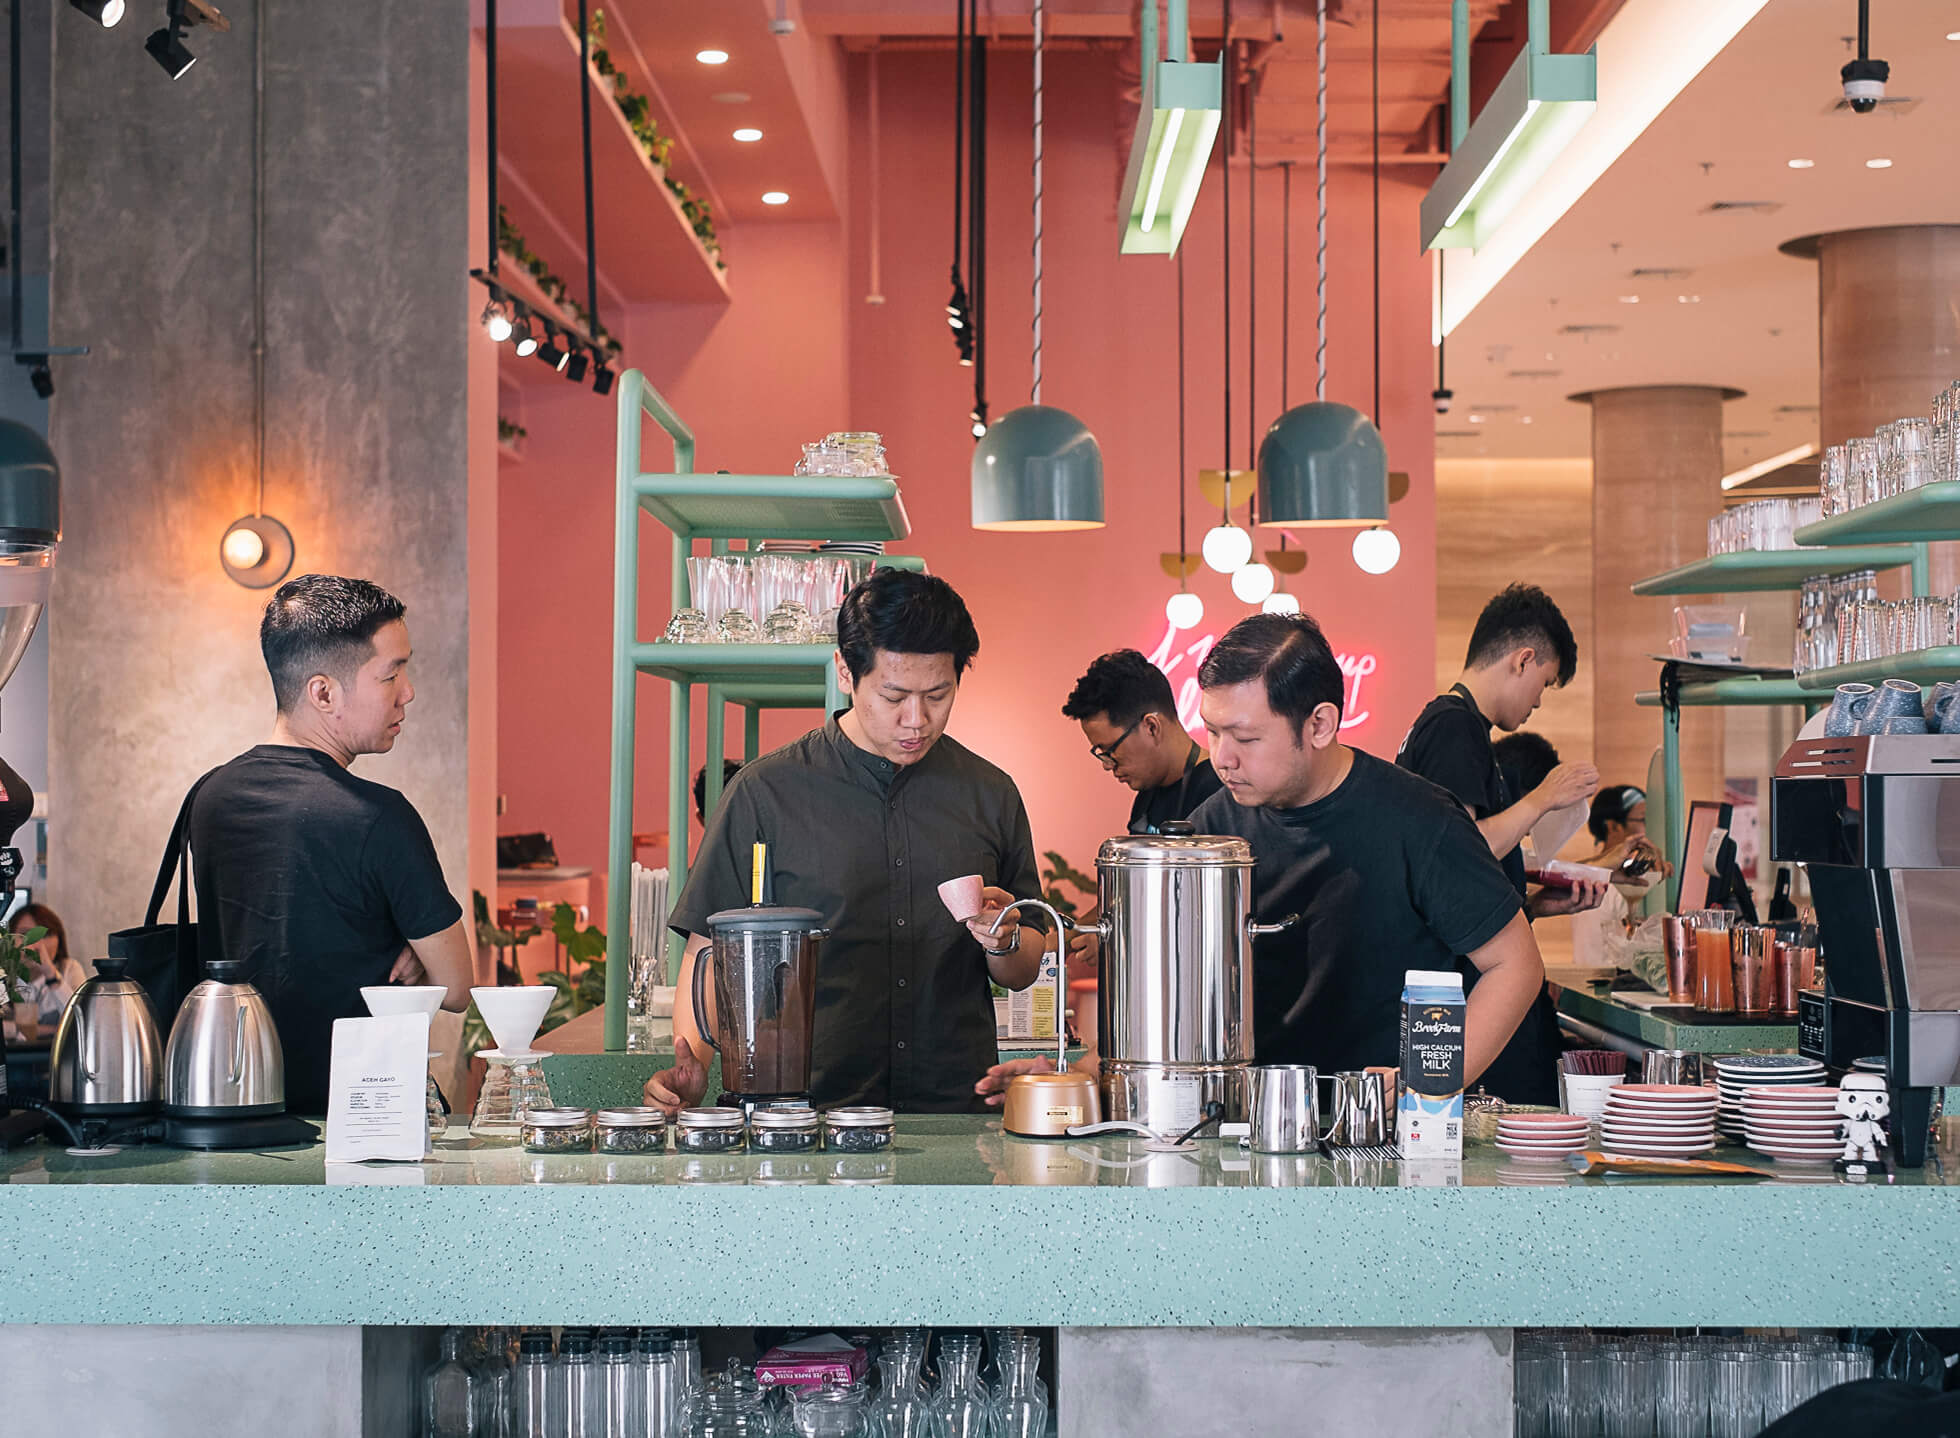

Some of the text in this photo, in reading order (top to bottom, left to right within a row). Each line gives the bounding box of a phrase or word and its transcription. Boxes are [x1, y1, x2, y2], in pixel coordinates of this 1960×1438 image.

[1412, 1043, 1429, 1051] HIGH
[1421, 1051, 1452, 1060] FRESH
[1422, 1060, 1451, 1070] MILK
